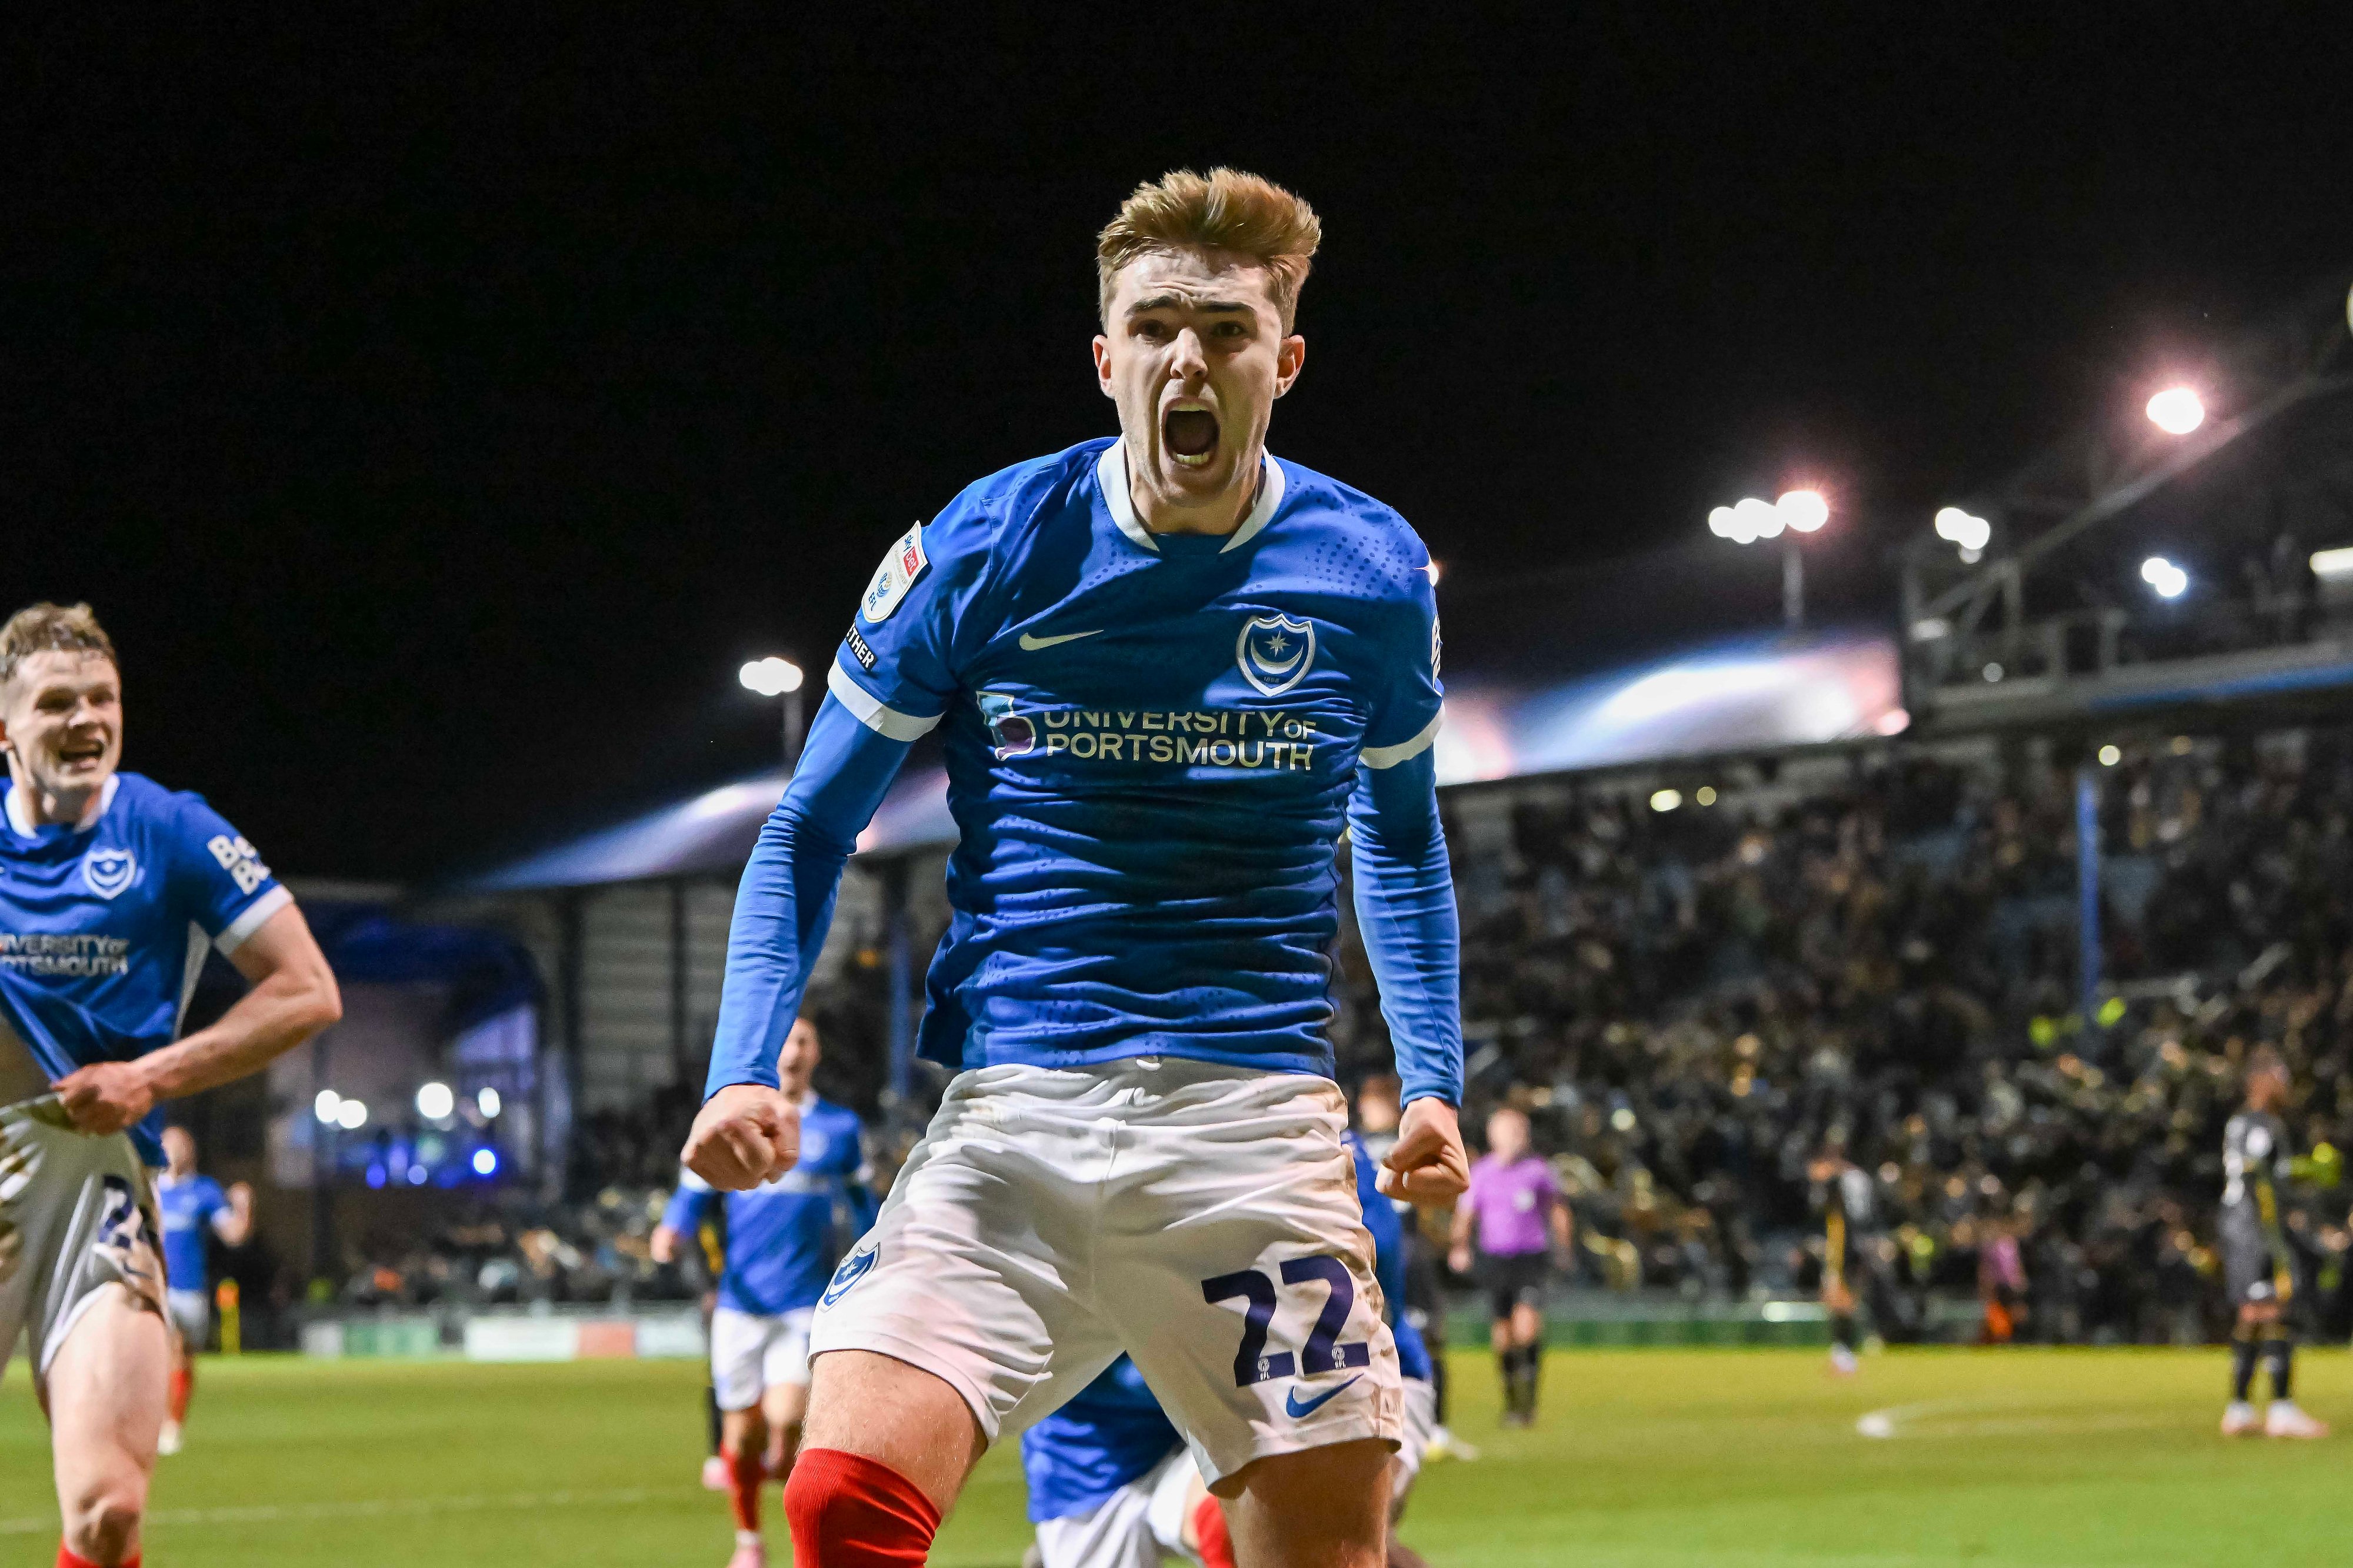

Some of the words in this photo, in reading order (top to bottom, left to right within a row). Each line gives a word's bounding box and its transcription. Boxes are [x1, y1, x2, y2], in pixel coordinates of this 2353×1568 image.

[906, 548, 916, 573] bet
[868, 591, 876, 612] EFL
[1044, 711, 1285, 737] UNIVERSITY
[1284, 719, 1317, 740] OF
[1046, 732, 1314, 770] PORTSMOUTH
[1201, 1254, 1371, 1389] 22
